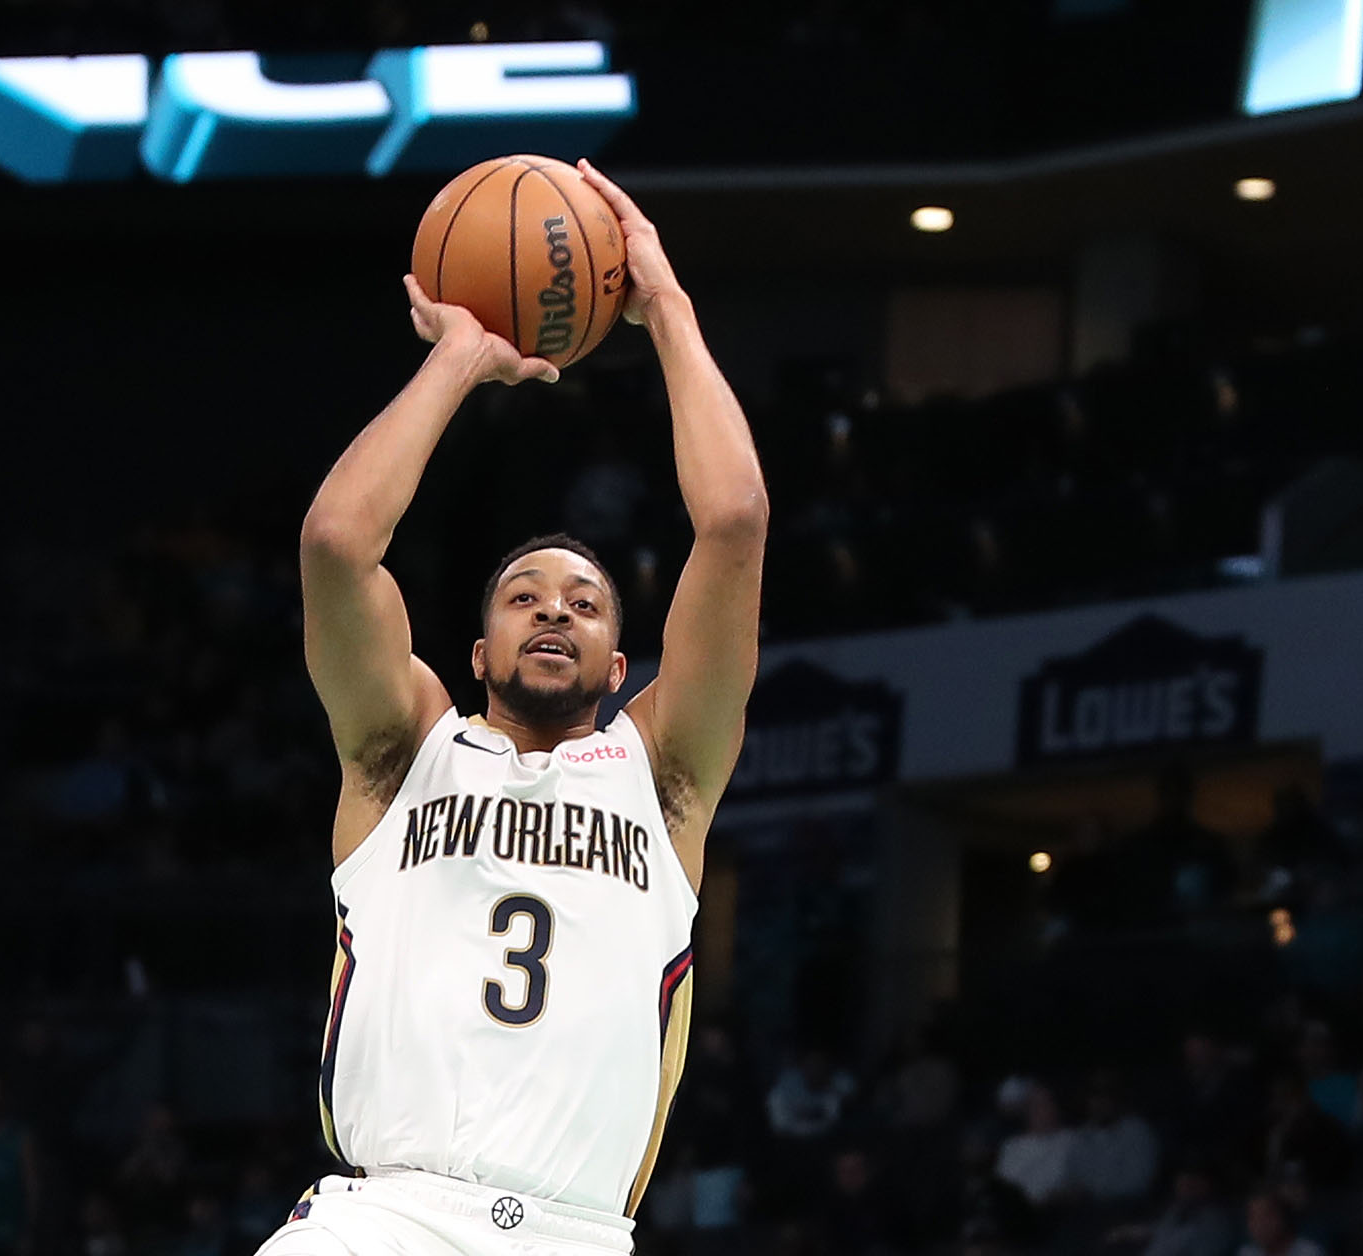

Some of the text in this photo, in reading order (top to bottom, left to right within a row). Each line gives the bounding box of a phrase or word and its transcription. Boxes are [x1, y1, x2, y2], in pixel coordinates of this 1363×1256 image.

[538, 215, 577, 354] Wilson
[733, 703, 880, 788] OWE'S
[1040, 662, 1239, 753] LOWE'S
[398, 794, 649, 892] NEW ORLEANS
[481, 893, 555, 1028] 3
